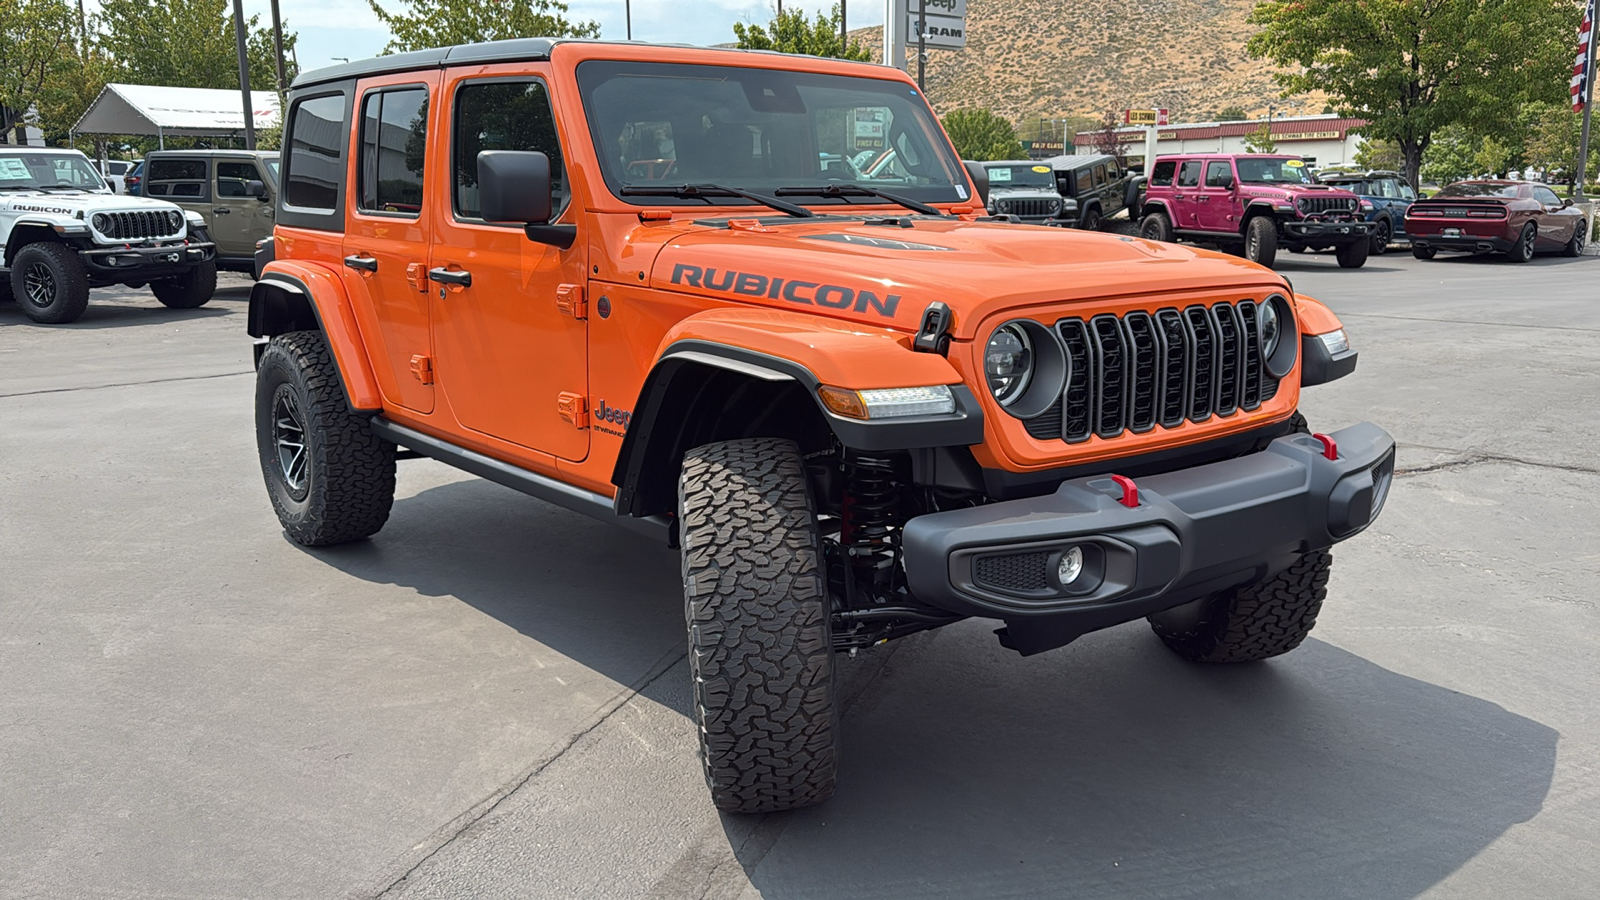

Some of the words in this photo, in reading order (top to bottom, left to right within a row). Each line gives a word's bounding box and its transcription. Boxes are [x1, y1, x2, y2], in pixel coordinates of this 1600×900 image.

[925, 0, 957, 12] eep
[929, 26, 962, 38] RAM
[1130, 112, 1139, 121] LES
[13, 204, 72, 214] RUBICON
[670, 262, 902, 318] RUBICON
[594, 399, 632, 430] Jeep
